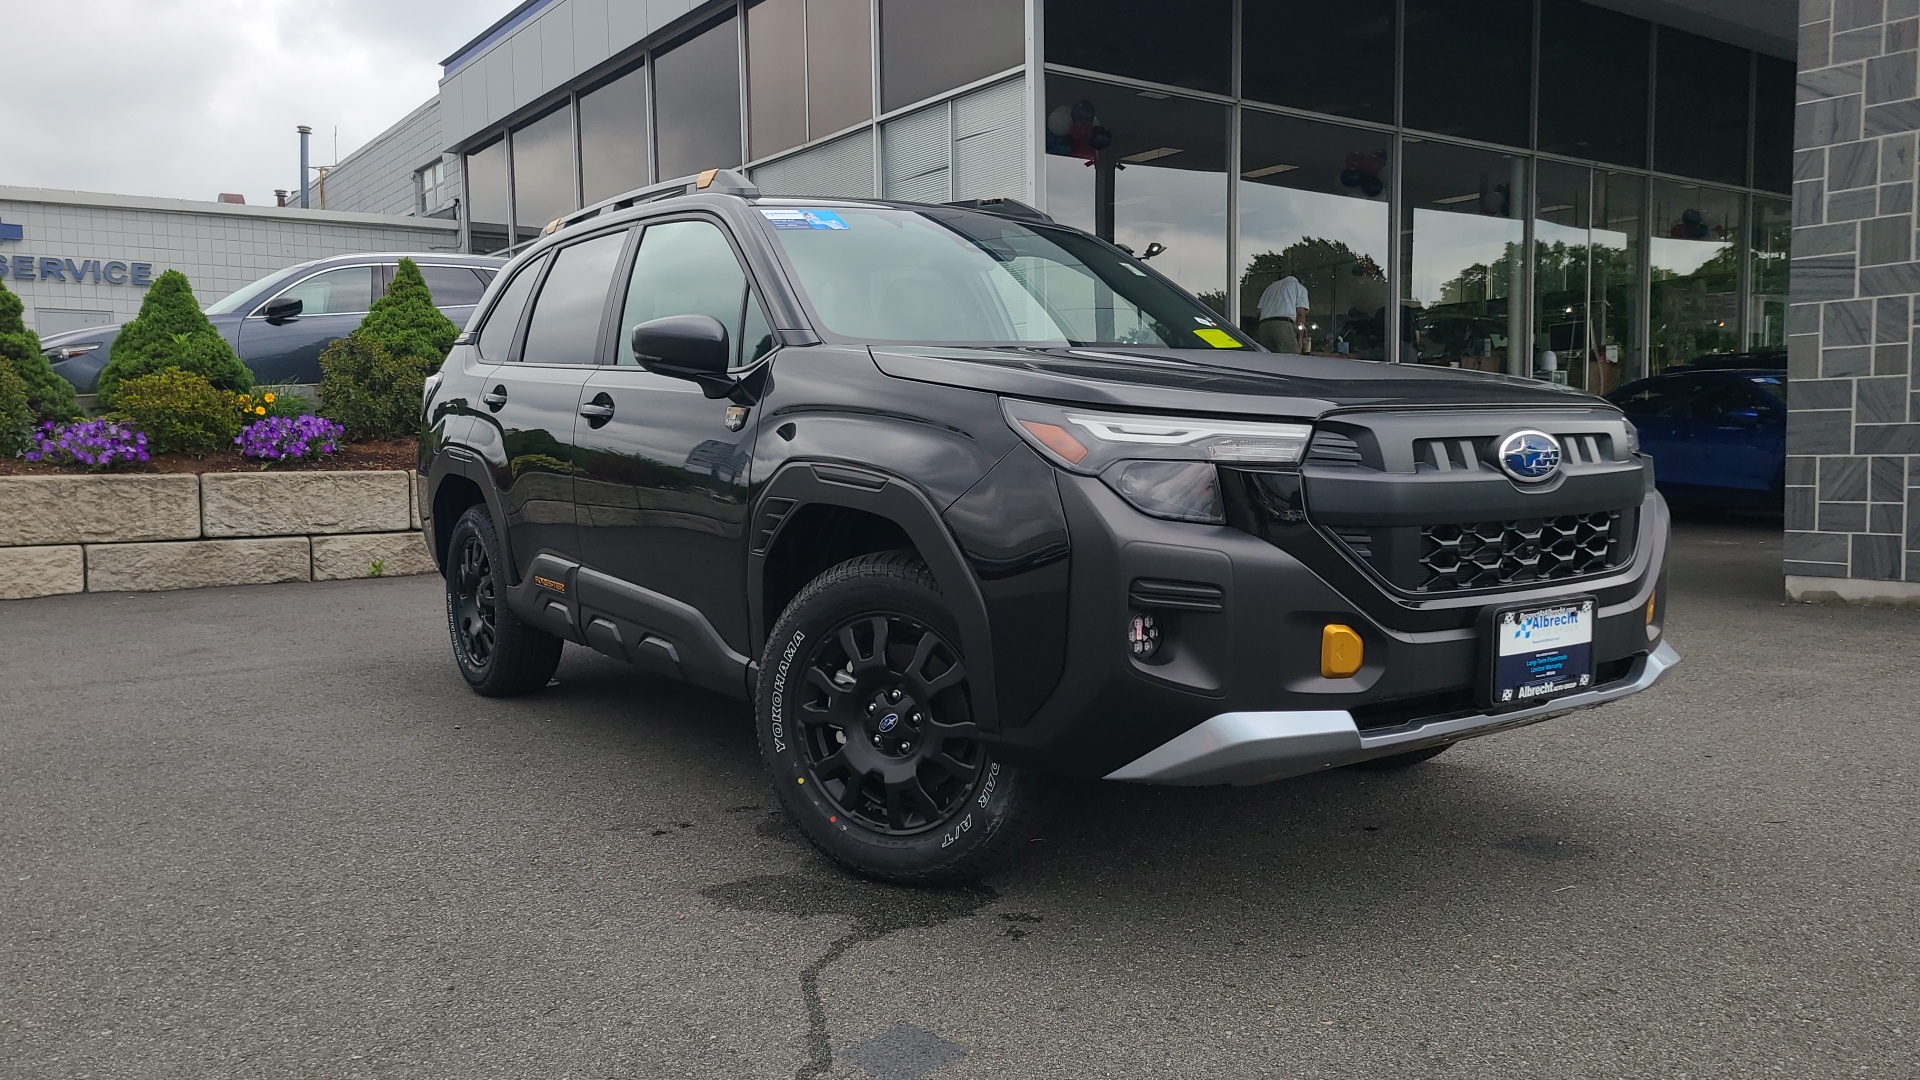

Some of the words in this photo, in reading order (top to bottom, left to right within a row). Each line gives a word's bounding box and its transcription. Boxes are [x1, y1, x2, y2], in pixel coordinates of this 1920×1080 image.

[534, 576, 566, 592] FORESTER
[1532, 612, 1578, 629] Albrecht
[770, 631, 806, 753] YOKOHAMA
[1518, 681, 1554, 699] Albrecht
[941, 814, 972, 848] A/T
